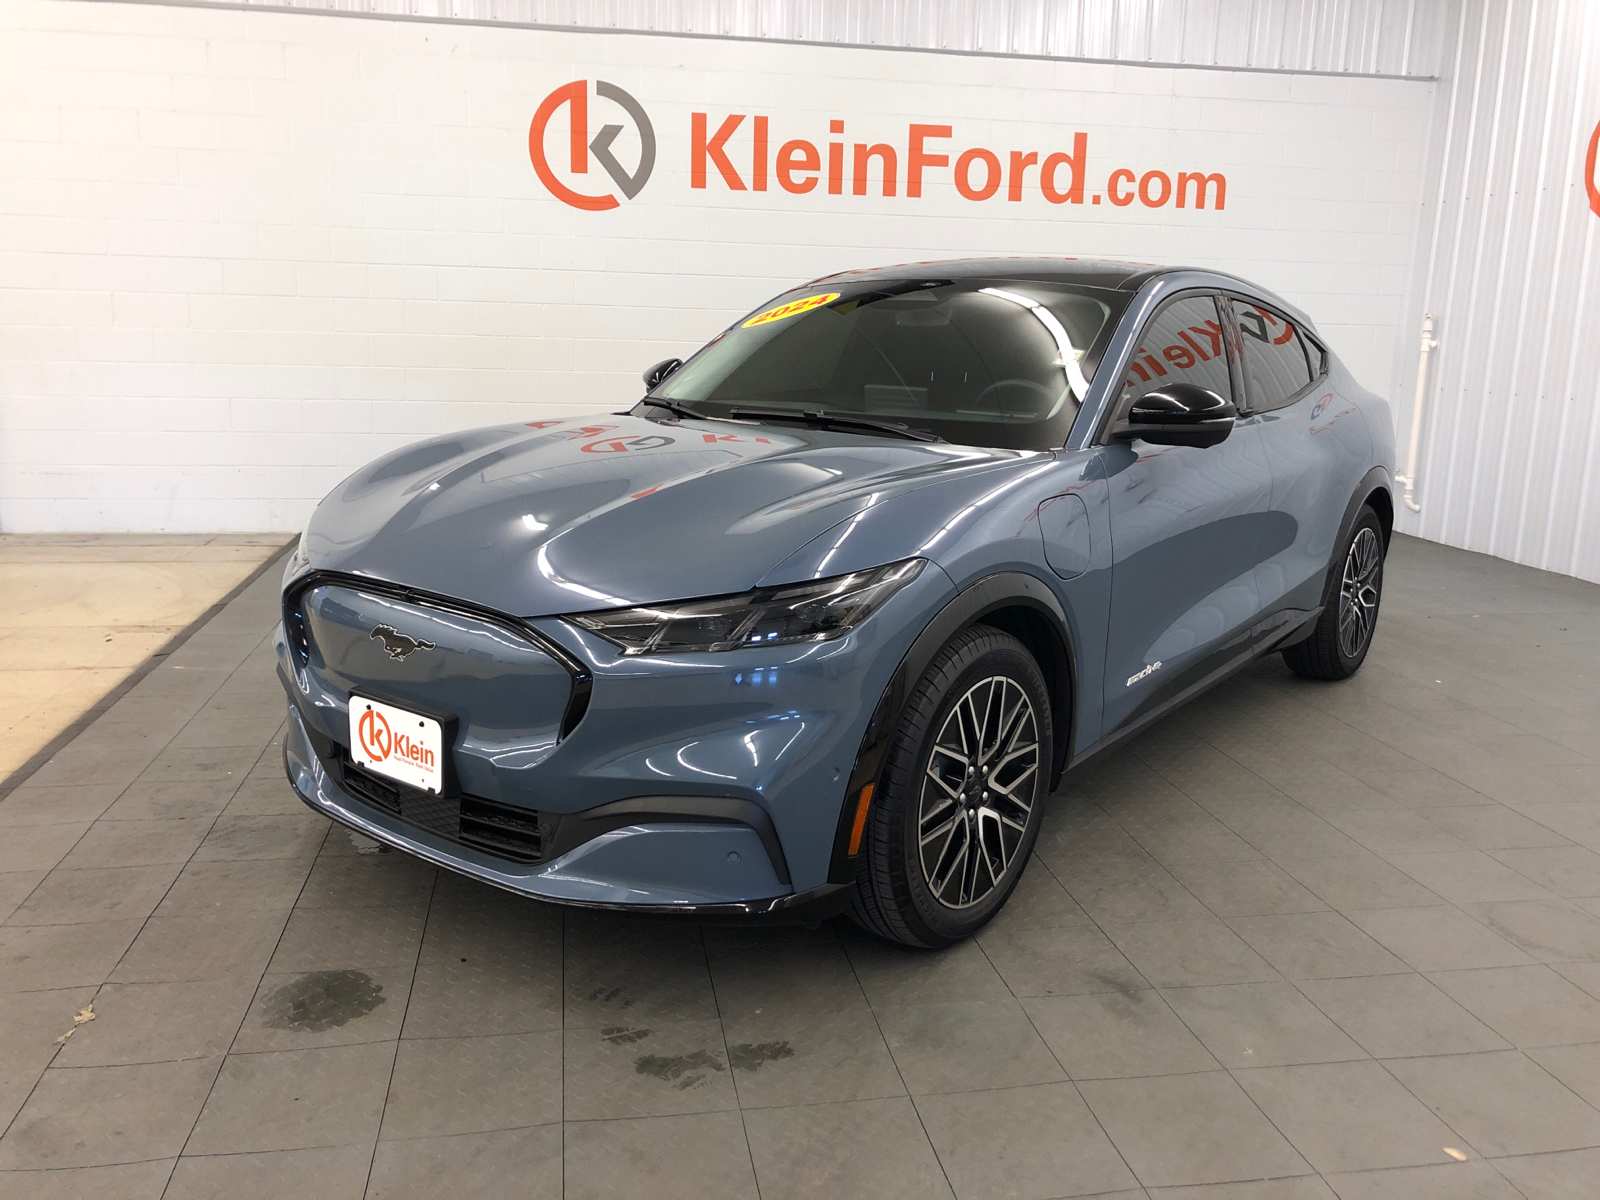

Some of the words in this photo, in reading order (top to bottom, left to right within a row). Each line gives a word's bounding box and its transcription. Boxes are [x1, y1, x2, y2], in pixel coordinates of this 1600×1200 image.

[690, 112, 1227, 211] KleinFord.com
[749, 294, 830, 326] 2024
[393, 732, 435, 768] Klein
